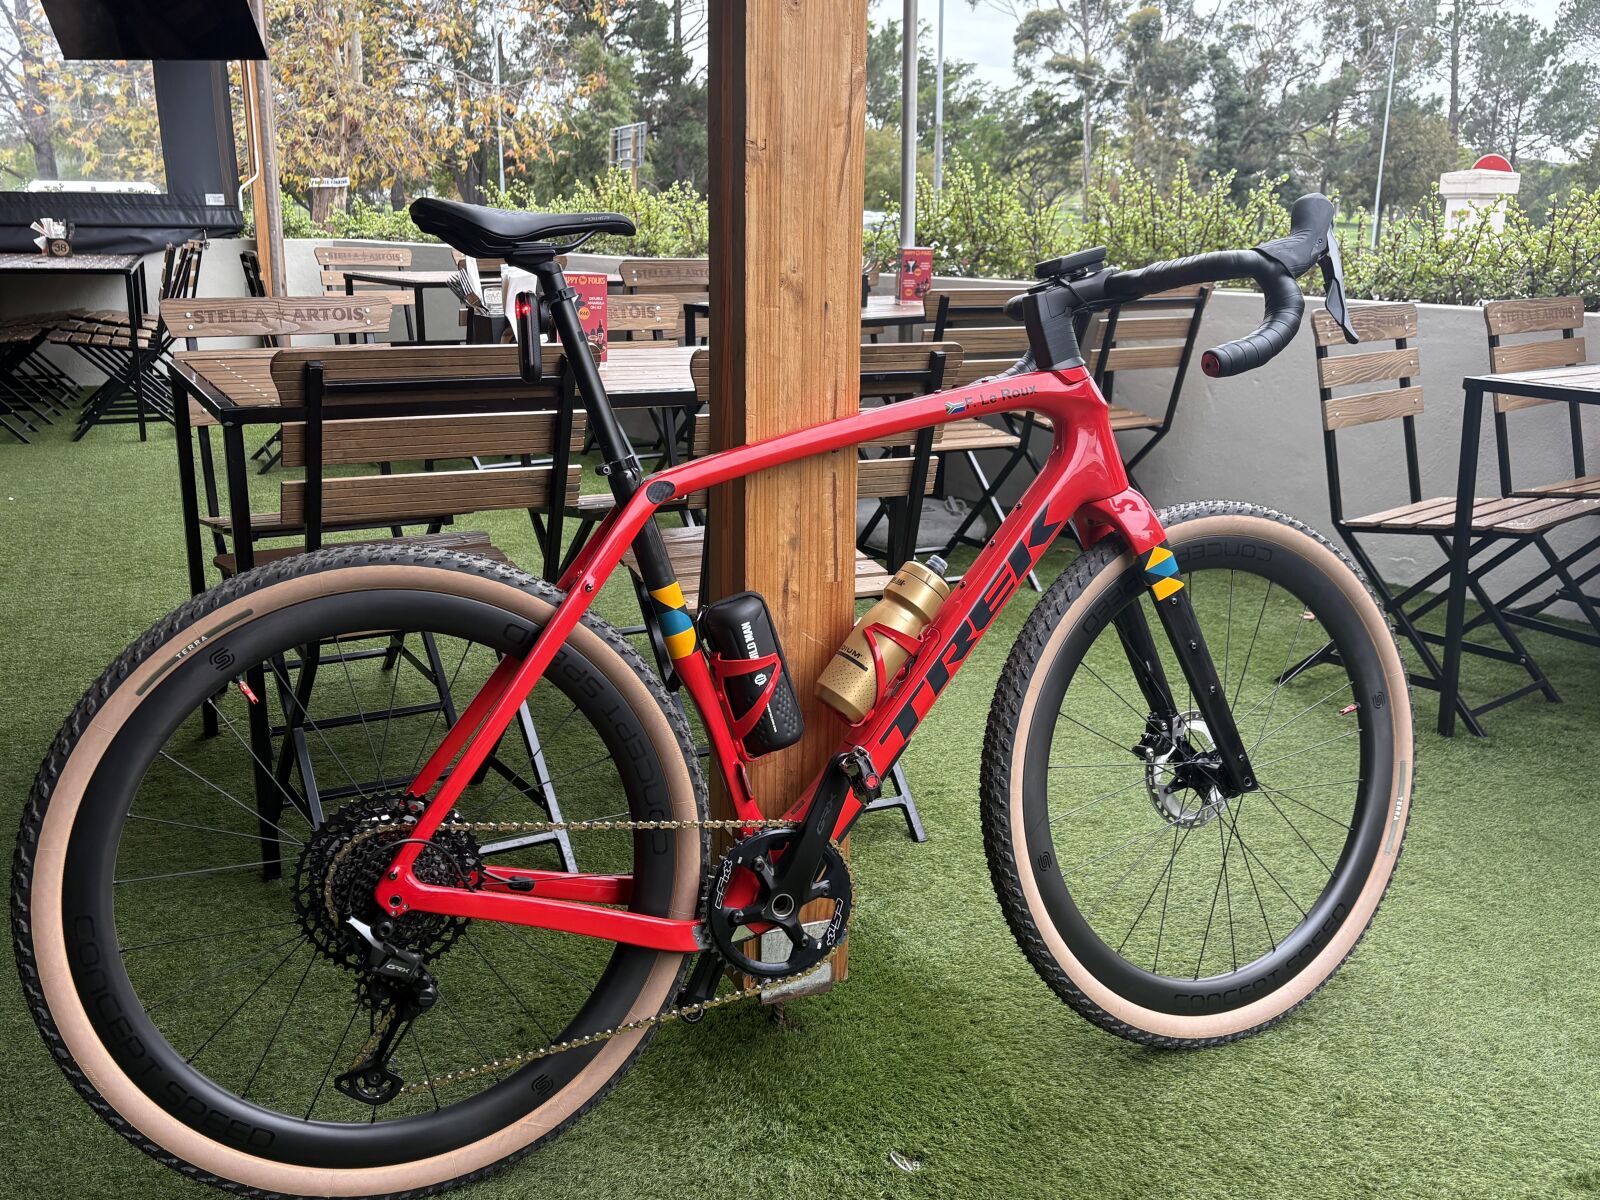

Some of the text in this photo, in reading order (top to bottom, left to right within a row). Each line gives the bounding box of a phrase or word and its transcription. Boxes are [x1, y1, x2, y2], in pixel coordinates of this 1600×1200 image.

[54, 243, 67, 252] 38
[369, 253, 400, 262] ARTOIS
[565, 276, 578, 284] APPY
[684, 268, 709, 277] ARTO
[193, 307, 364, 324] STELLA ARTOIS
[608, 305, 657, 319] RTOIS
[1540, 306, 1574, 320] ARTOIS
[964, 385, 1038, 409] F. Le Roux
[1176, 542, 1273, 563] CONCEP
[741, 621, 755, 643] MAN
[879, 502, 1062, 746] TREK
[175, 635, 208, 659] TERRA
[816, 792, 838, 836] GRX
[386, 964, 410, 973] GRX
[74, 915, 276, 1149] CONCEPT SPEED
